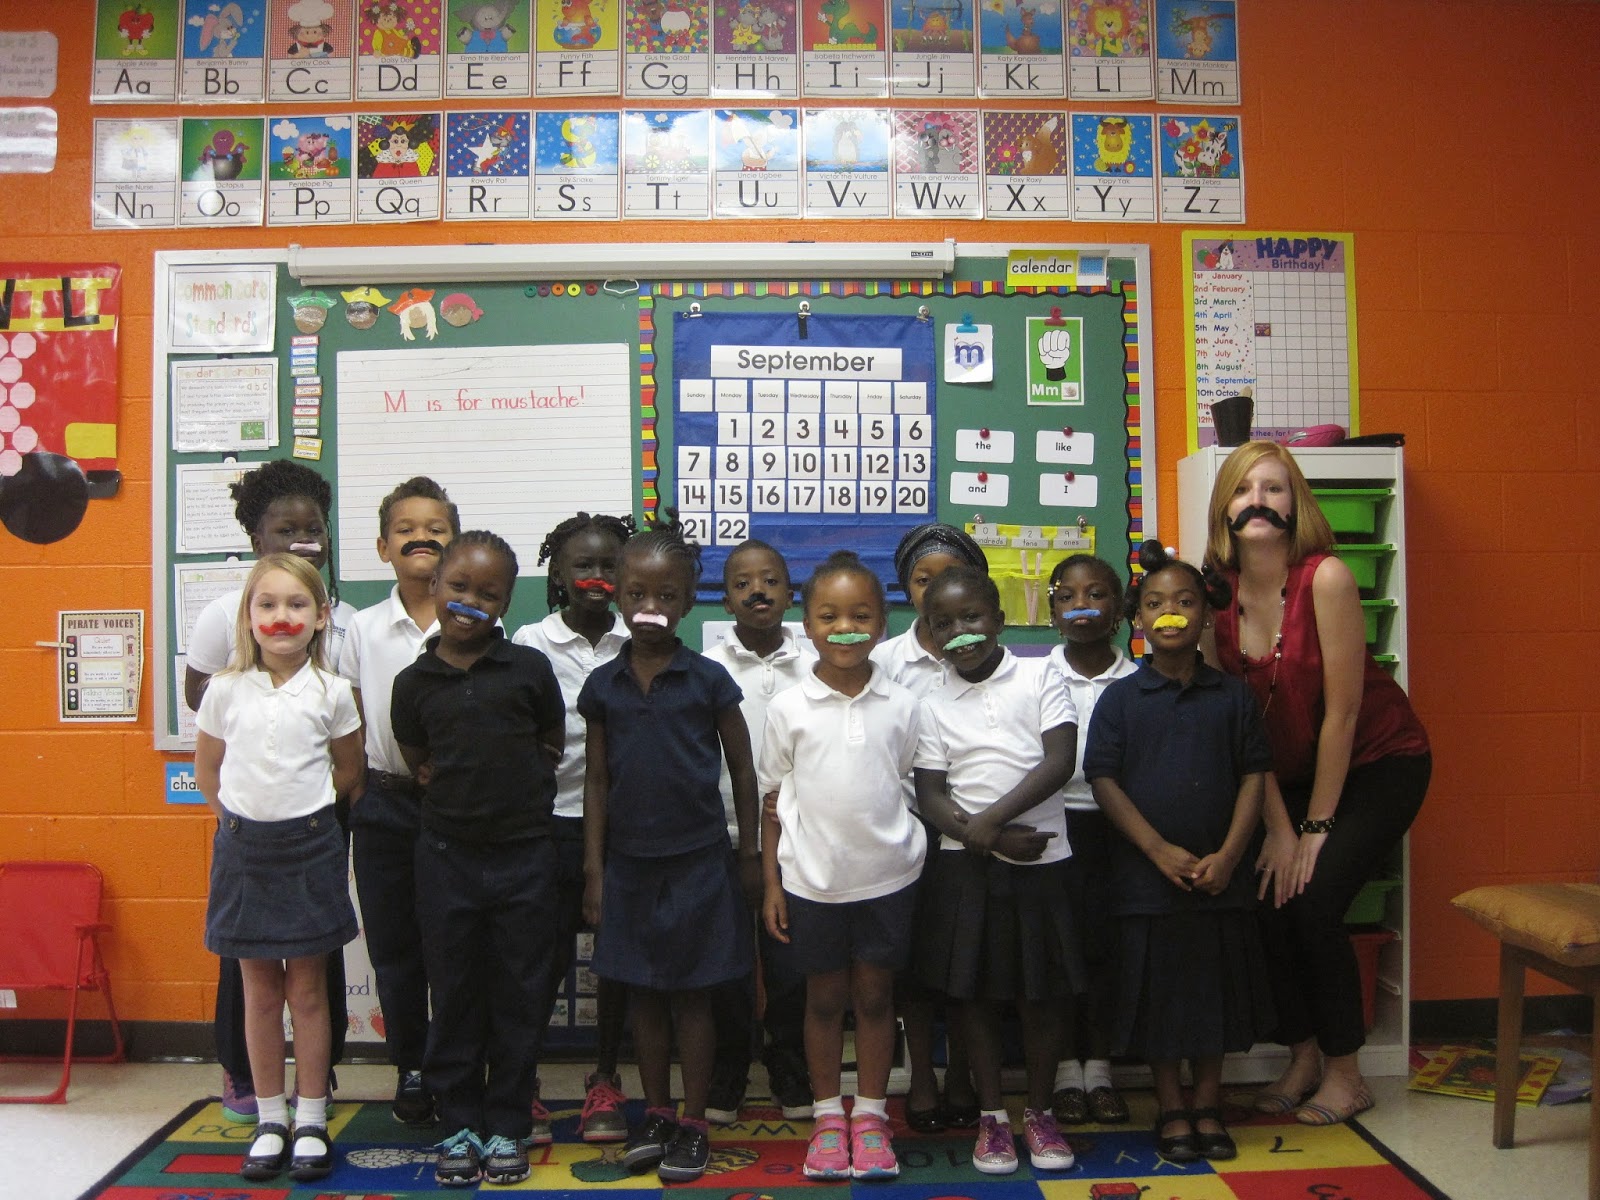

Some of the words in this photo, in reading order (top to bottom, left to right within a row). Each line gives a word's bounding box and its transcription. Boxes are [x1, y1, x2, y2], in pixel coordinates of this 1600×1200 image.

[916, 53, 938, 61] Jungle
[114, 69, 150, 94] Aa
[205, 68, 240, 94] Bb
[286, 68, 329, 94] Cc
[379, 64, 417, 91] Dd
[467, 63, 507, 89] Ee
[560, 61, 591, 87] Ff
[641, 62, 688, 95] Gg
[735, 63, 780, 90] Hh
[829, 61, 859, 88] Ii
[917, 62, 944, 93] Jj
[1005, 63, 1040, 90] Kk
[1096, 66, 1121, 92] Ll
[1171, 68, 1224, 95] Mm
[289, 181, 319, 189] Penelope
[647, 183, 681, 210] Tt
[739, 180, 778, 207] Uu
[827, 180, 867, 207] Vv
[911, 182, 966, 209] Ww
[115, 192, 153, 219] Nn
[198, 190, 240, 216] Oo
[296, 187, 330, 220] Pp
[376, 187, 420, 217] Qq
[470, 186, 502, 212] Rr
[558, 184, 591, 212] Ss
[1006, 184, 1046, 211] Xx
[1093, 185, 1132, 217] Yy
[1184, 186, 1220, 214] Zz
[1255, 237, 1338, 260] HAPPY
[1011, 261, 1073, 274] calendar
[1272, 258, 1325, 270] Birthday!
[1212, 273, 1243, 281] January
[1194, 285, 1208, 293] 2nd
[1212, 286, 1245, 294] February
[1213, 298, 1237, 306] March
[1213, 312, 1232, 320] April
[1195, 324, 1208, 332] 5th
[1213, 325, 1229, 333] May
[1195, 337, 1209, 345] 6th
[737, 349, 875, 374] September
[1215, 350, 1232, 359] July
[1215, 363, 1242, 372] August
[1032, 383, 1059, 396] Mm
[1197, 376, 1209, 384] 9th
[1215, 376, 1257, 386] September
[1197, 389, 1214, 397] 10th
[384, 389, 407, 412] M
[427, 395, 442, 412] is
[456, 389, 481, 411] for
[491, 386, 585, 409] mustache!
[790, 392, 819, 400] Wednesday
[867, 393, 883, 401] Friday
[730, 419, 737, 438] 1
[762, 419, 775, 439] 2
[797, 419, 810, 439] 3
[834, 420, 849, 439] 4
[870, 420, 884, 440] 5
[909, 420, 923, 440] 6
[1197, 416, 1213, 424] 12th
[975, 440, 991, 450] the
[1055, 442, 1072, 452] like
[688, 452, 700, 472] 7
[726, 452, 739, 472] 8
[762, 452, 776, 472] 9
[793, 453, 817, 473] 10
[832, 453, 851, 473] 11
[866, 454, 889, 474] 12
[903, 453, 926, 473] 13
[683, 485, 706, 505] 14
[719, 485, 742, 505] 15
[757, 485, 780, 505] 16
[793, 486, 816, 506] 17
[828, 486, 851, 506] 18
[864, 487, 887, 507] 19
[899, 487, 926, 507] 20
[968, 484, 987, 494] and
[1063, 485, 1068, 494] I
[684, 519, 706, 538] 21
[718, 519, 746, 538] 22
[68, 619, 99, 629] PIRATE
[104, 619, 134, 628] VOICES
[173, 775, 199, 790] cha
